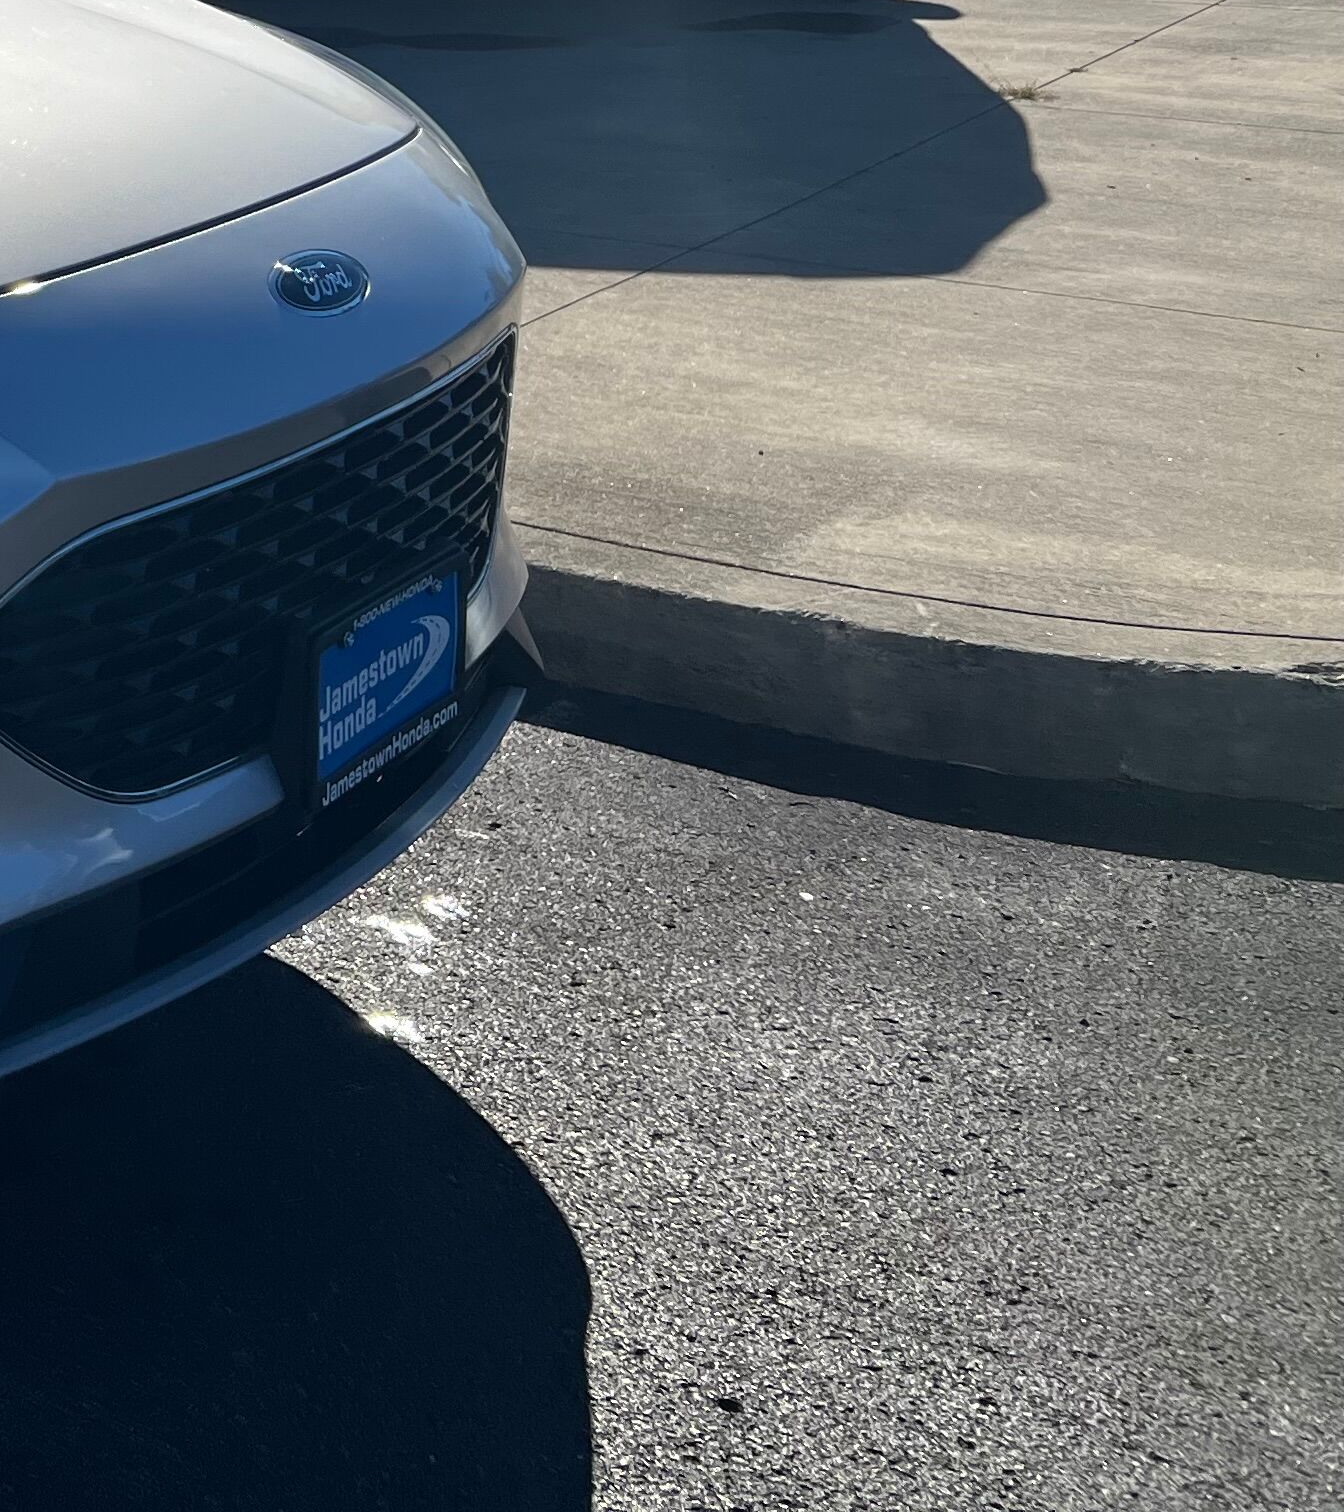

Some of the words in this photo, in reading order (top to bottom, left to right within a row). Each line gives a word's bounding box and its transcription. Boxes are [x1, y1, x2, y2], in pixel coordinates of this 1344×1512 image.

[294, 261, 352, 302] Ford
[320, 633, 424, 723] Jamestown
[319, 697, 377, 760] Honda
[322, 701, 458, 807] JamestownHonda.com
